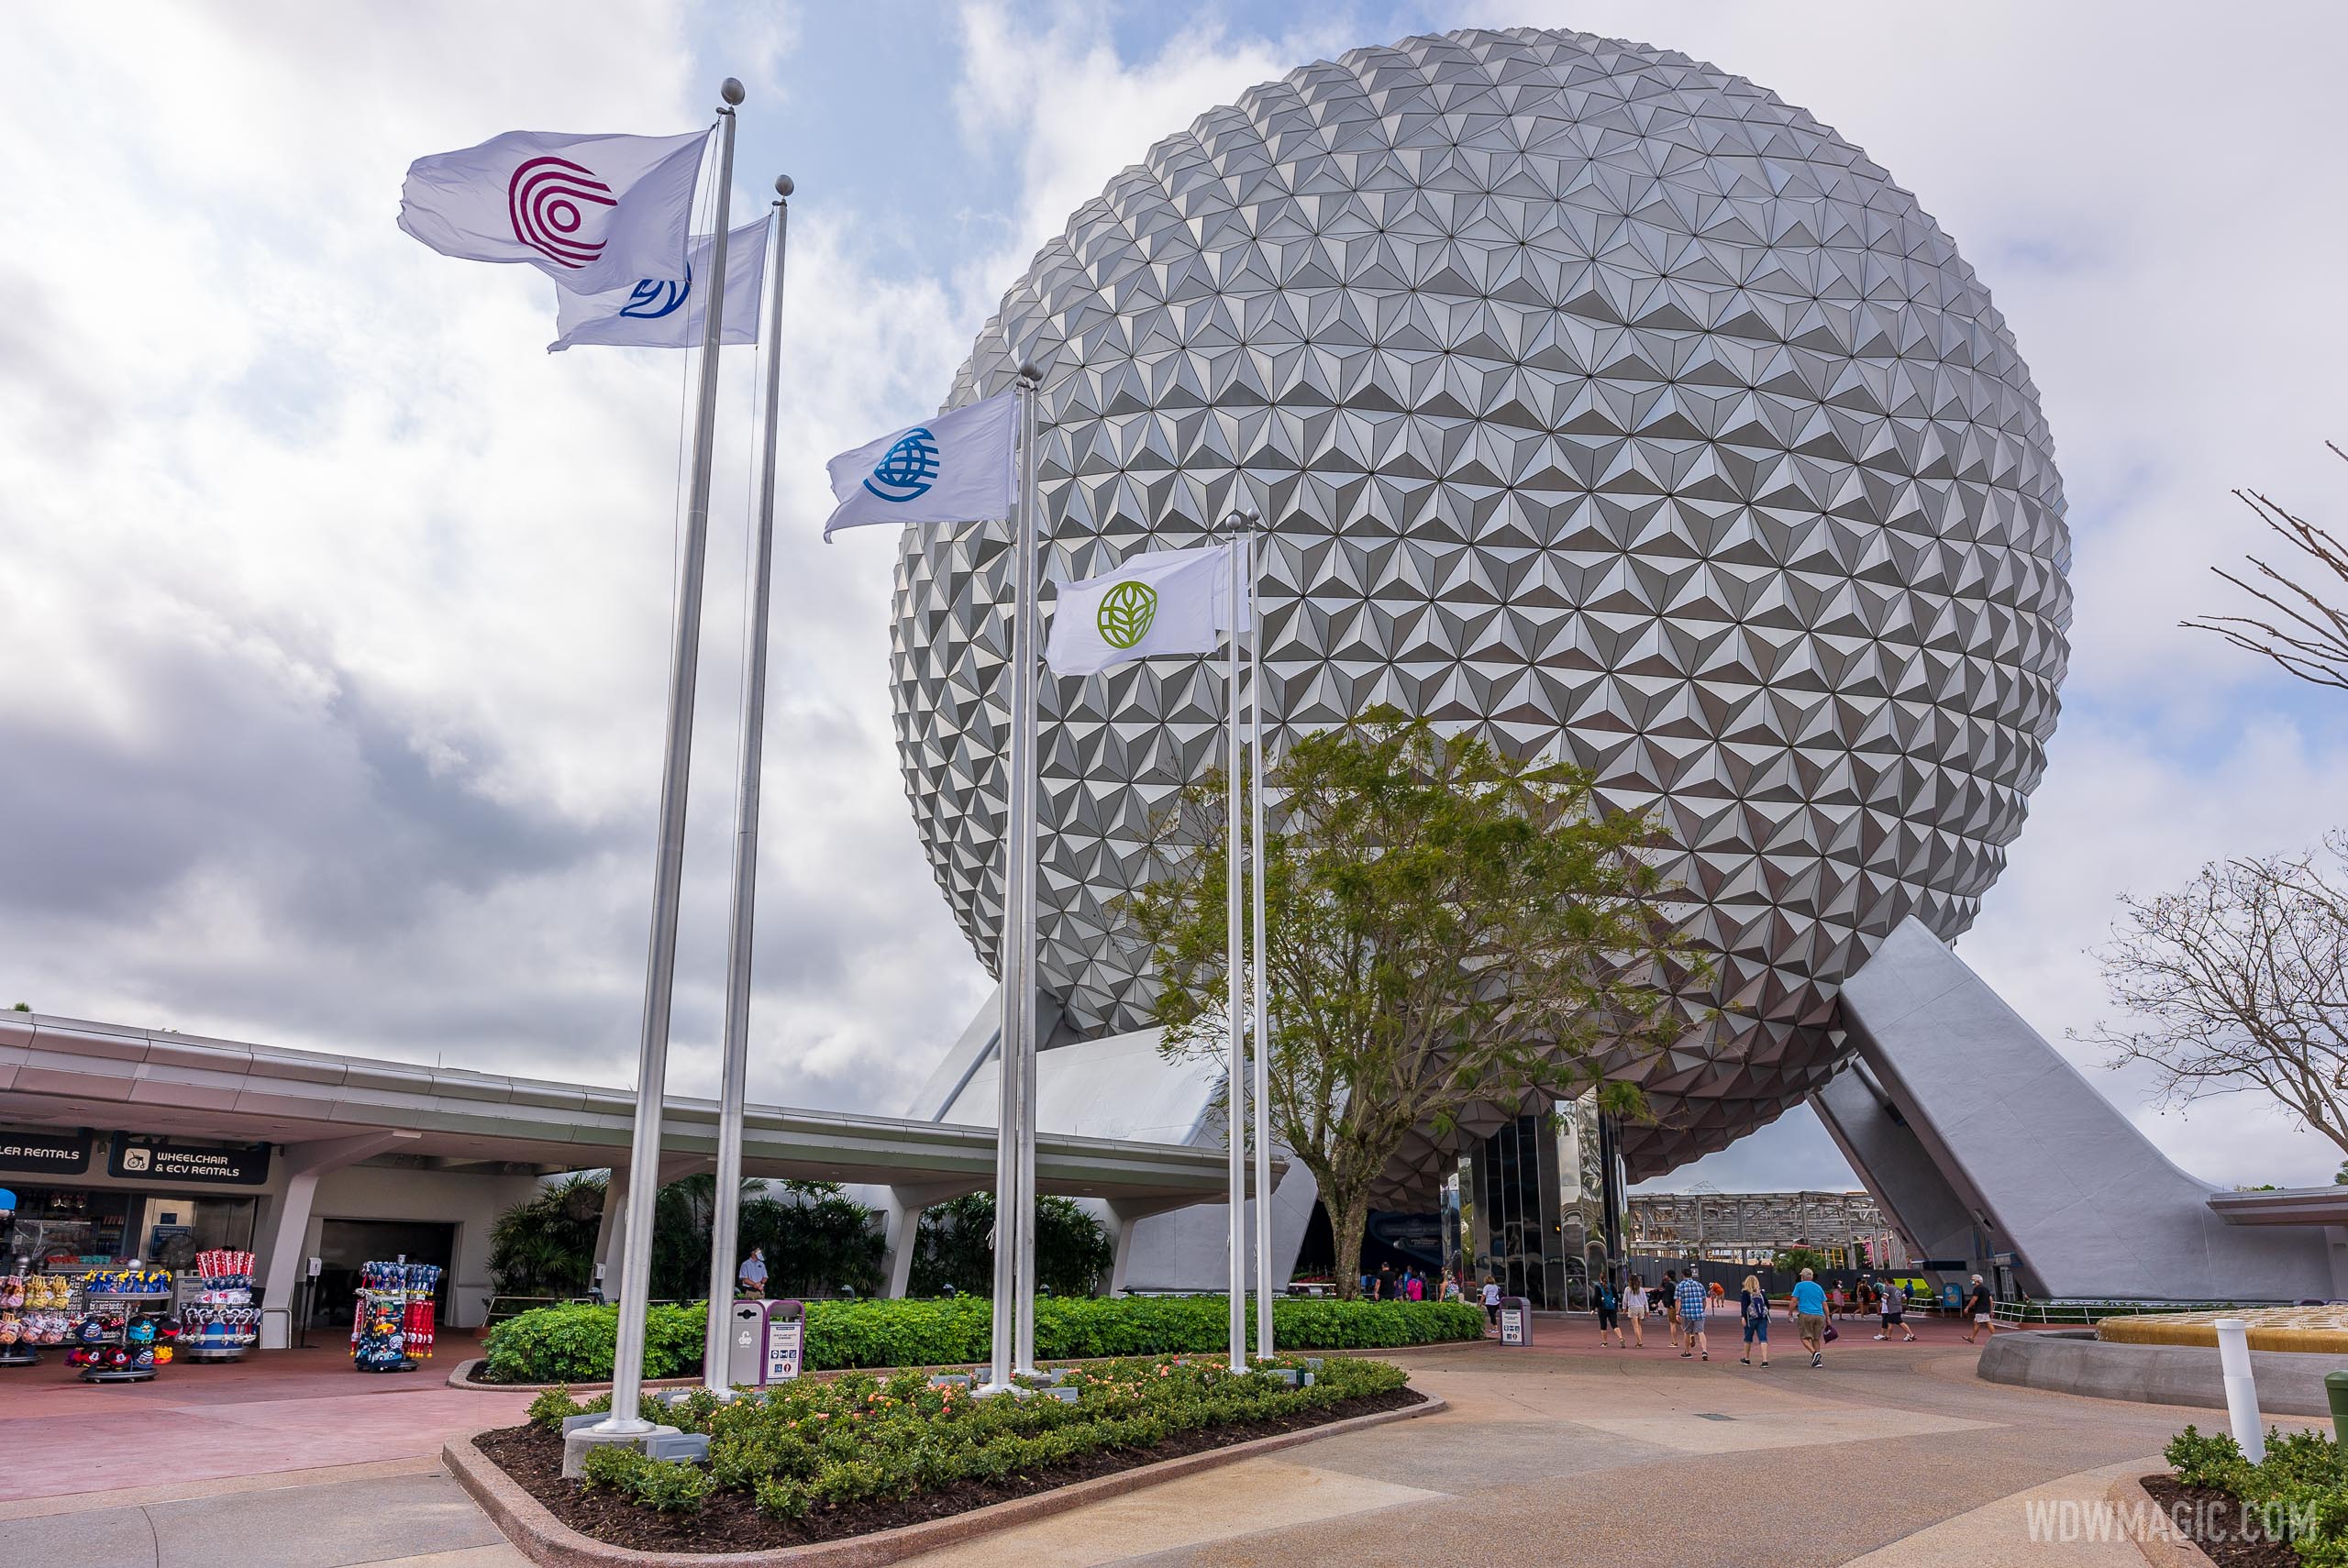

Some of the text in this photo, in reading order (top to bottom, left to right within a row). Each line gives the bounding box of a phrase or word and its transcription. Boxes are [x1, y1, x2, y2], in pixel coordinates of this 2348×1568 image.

[24, 1147, 80, 1160] RENTALS
[157, 1152, 228, 1165] WHEELCHAIR
[155, 1165, 240, 1176] & ECV RENTALS
